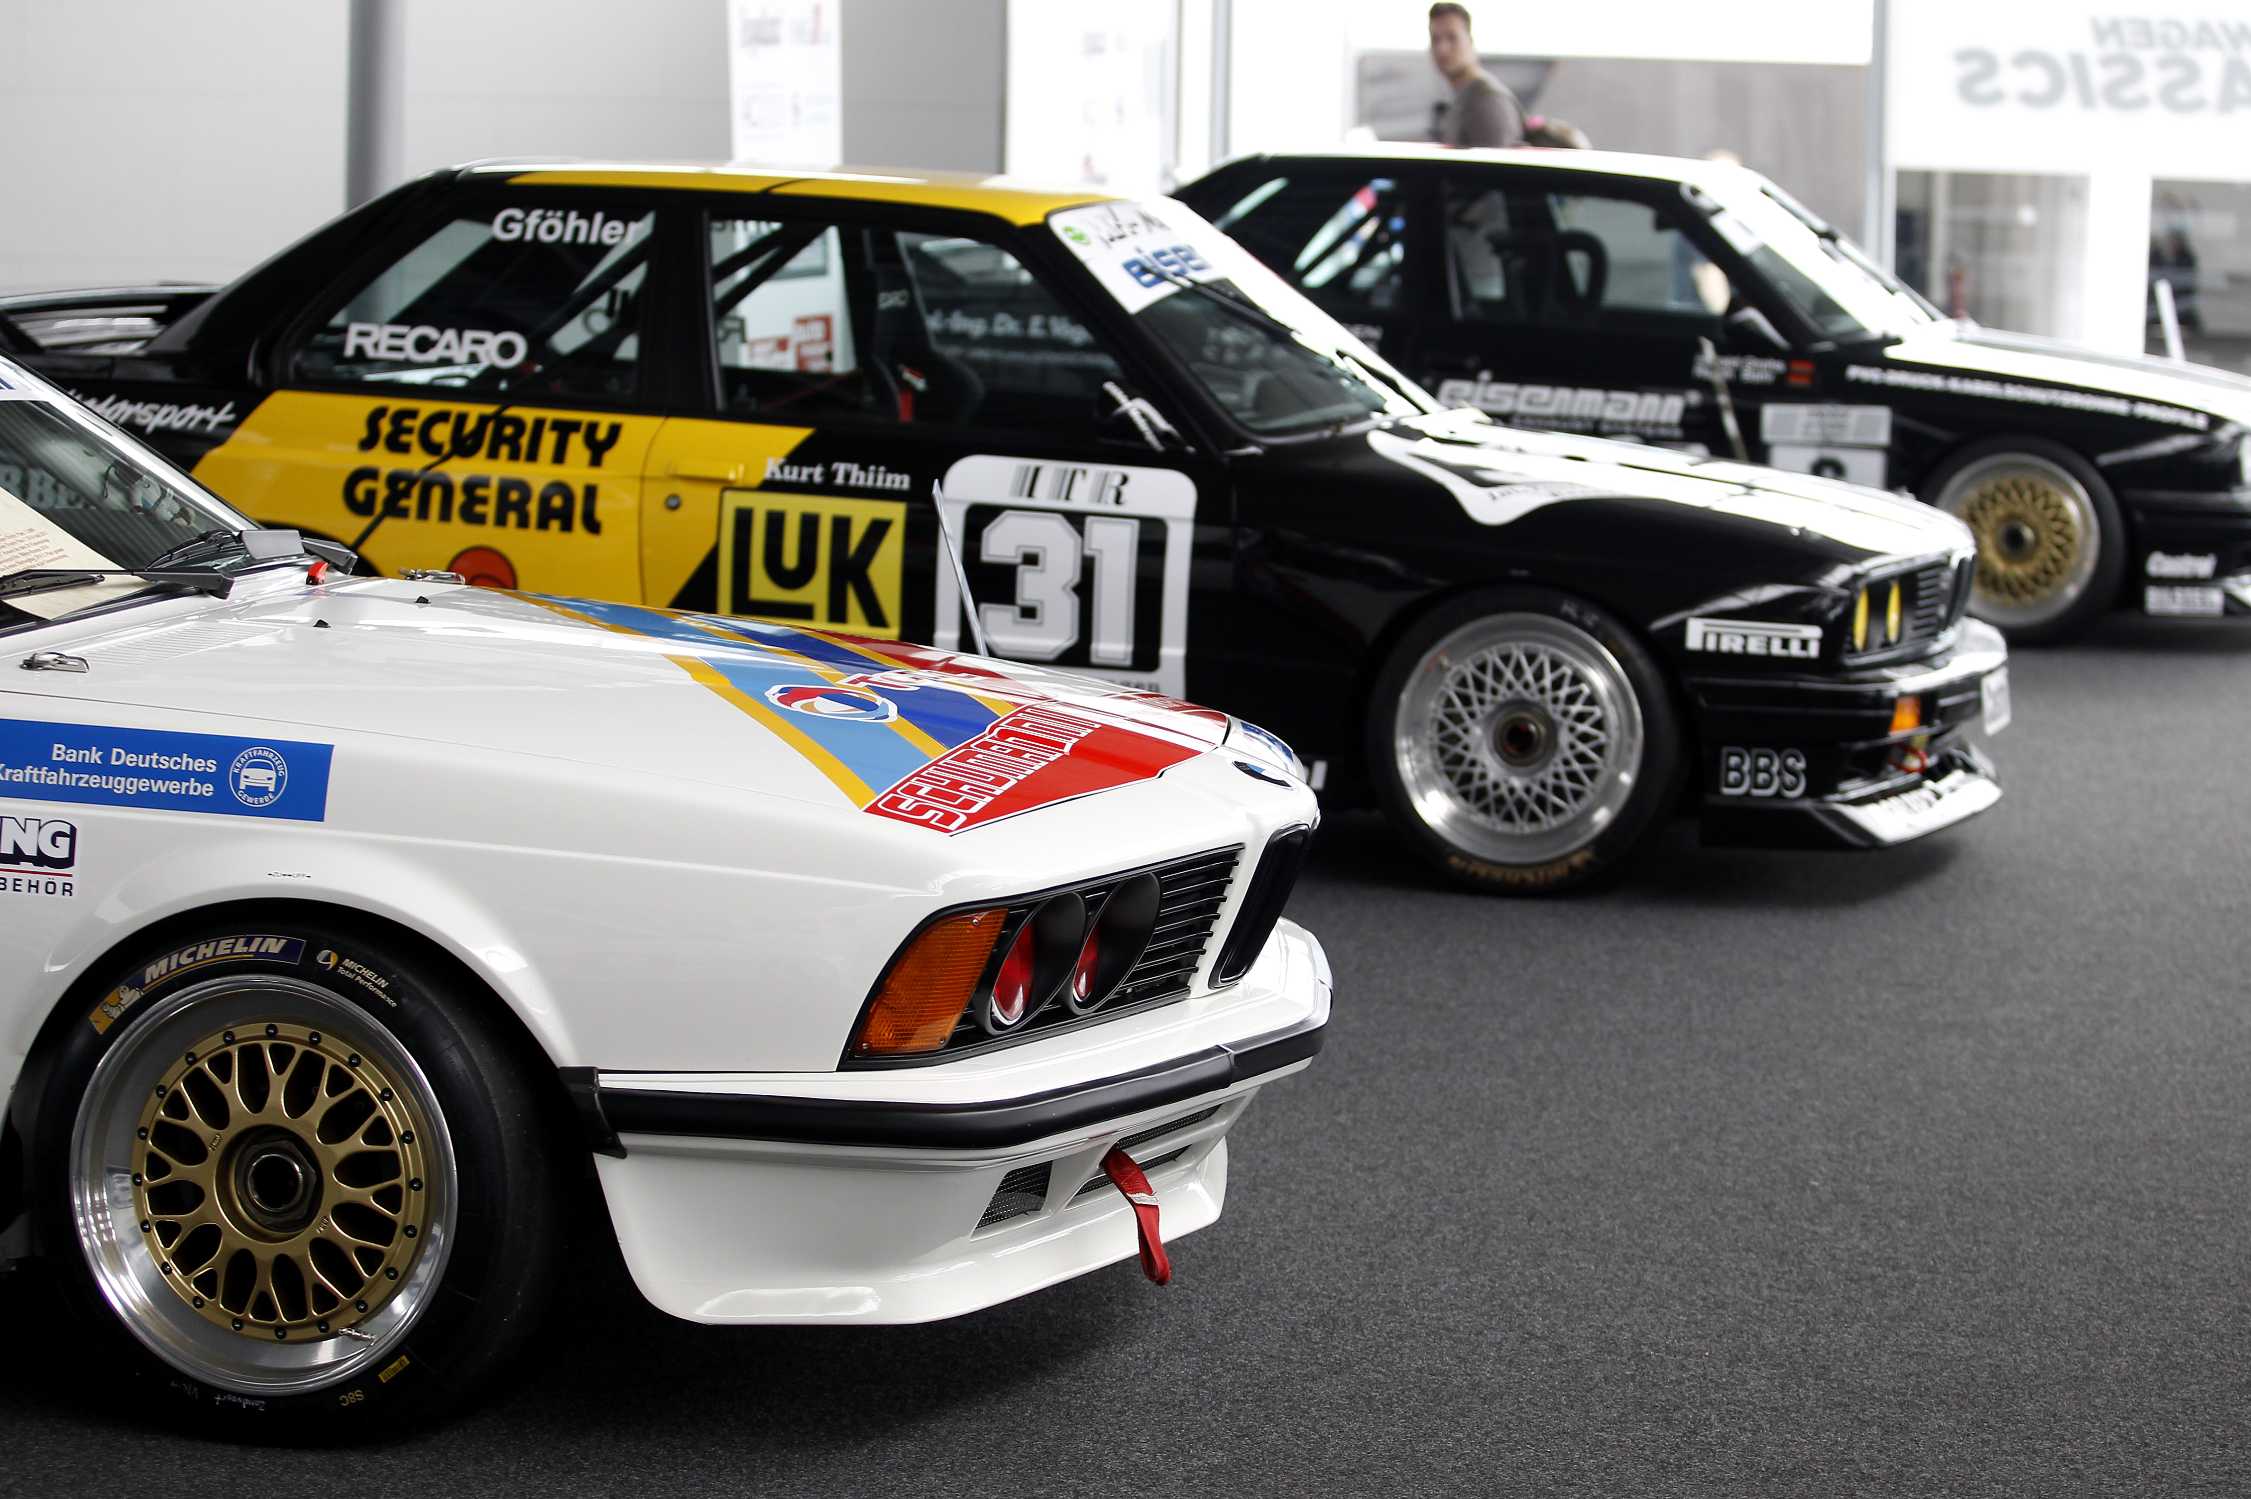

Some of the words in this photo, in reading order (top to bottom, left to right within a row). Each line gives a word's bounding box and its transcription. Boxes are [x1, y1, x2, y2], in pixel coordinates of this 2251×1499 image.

[492, 207, 645, 246] Gföhler
[343, 322, 528, 369] RECARO
[357, 405, 624, 468] SECURITY
[764, 456, 825, 484] Kurt
[831, 461, 911, 491] Thiim
[1008, 464, 1130, 506] ITR
[342, 466, 603, 536] GENERAL
[979, 508, 1140, 667] 31
[1685, 616, 1823, 660] PIRELLI
[52, 743, 103, 765] Bank
[111, 747, 217, 773] Deutsches
[232, 749, 285, 777] KRAFTFAHRZEUG
[1721, 746, 1807, 799] BBS
[237, 790, 275, 804] GEWERBE
[144, 937, 287, 984] MICHELIN
[342, 958, 390, 988] MICHELIN
